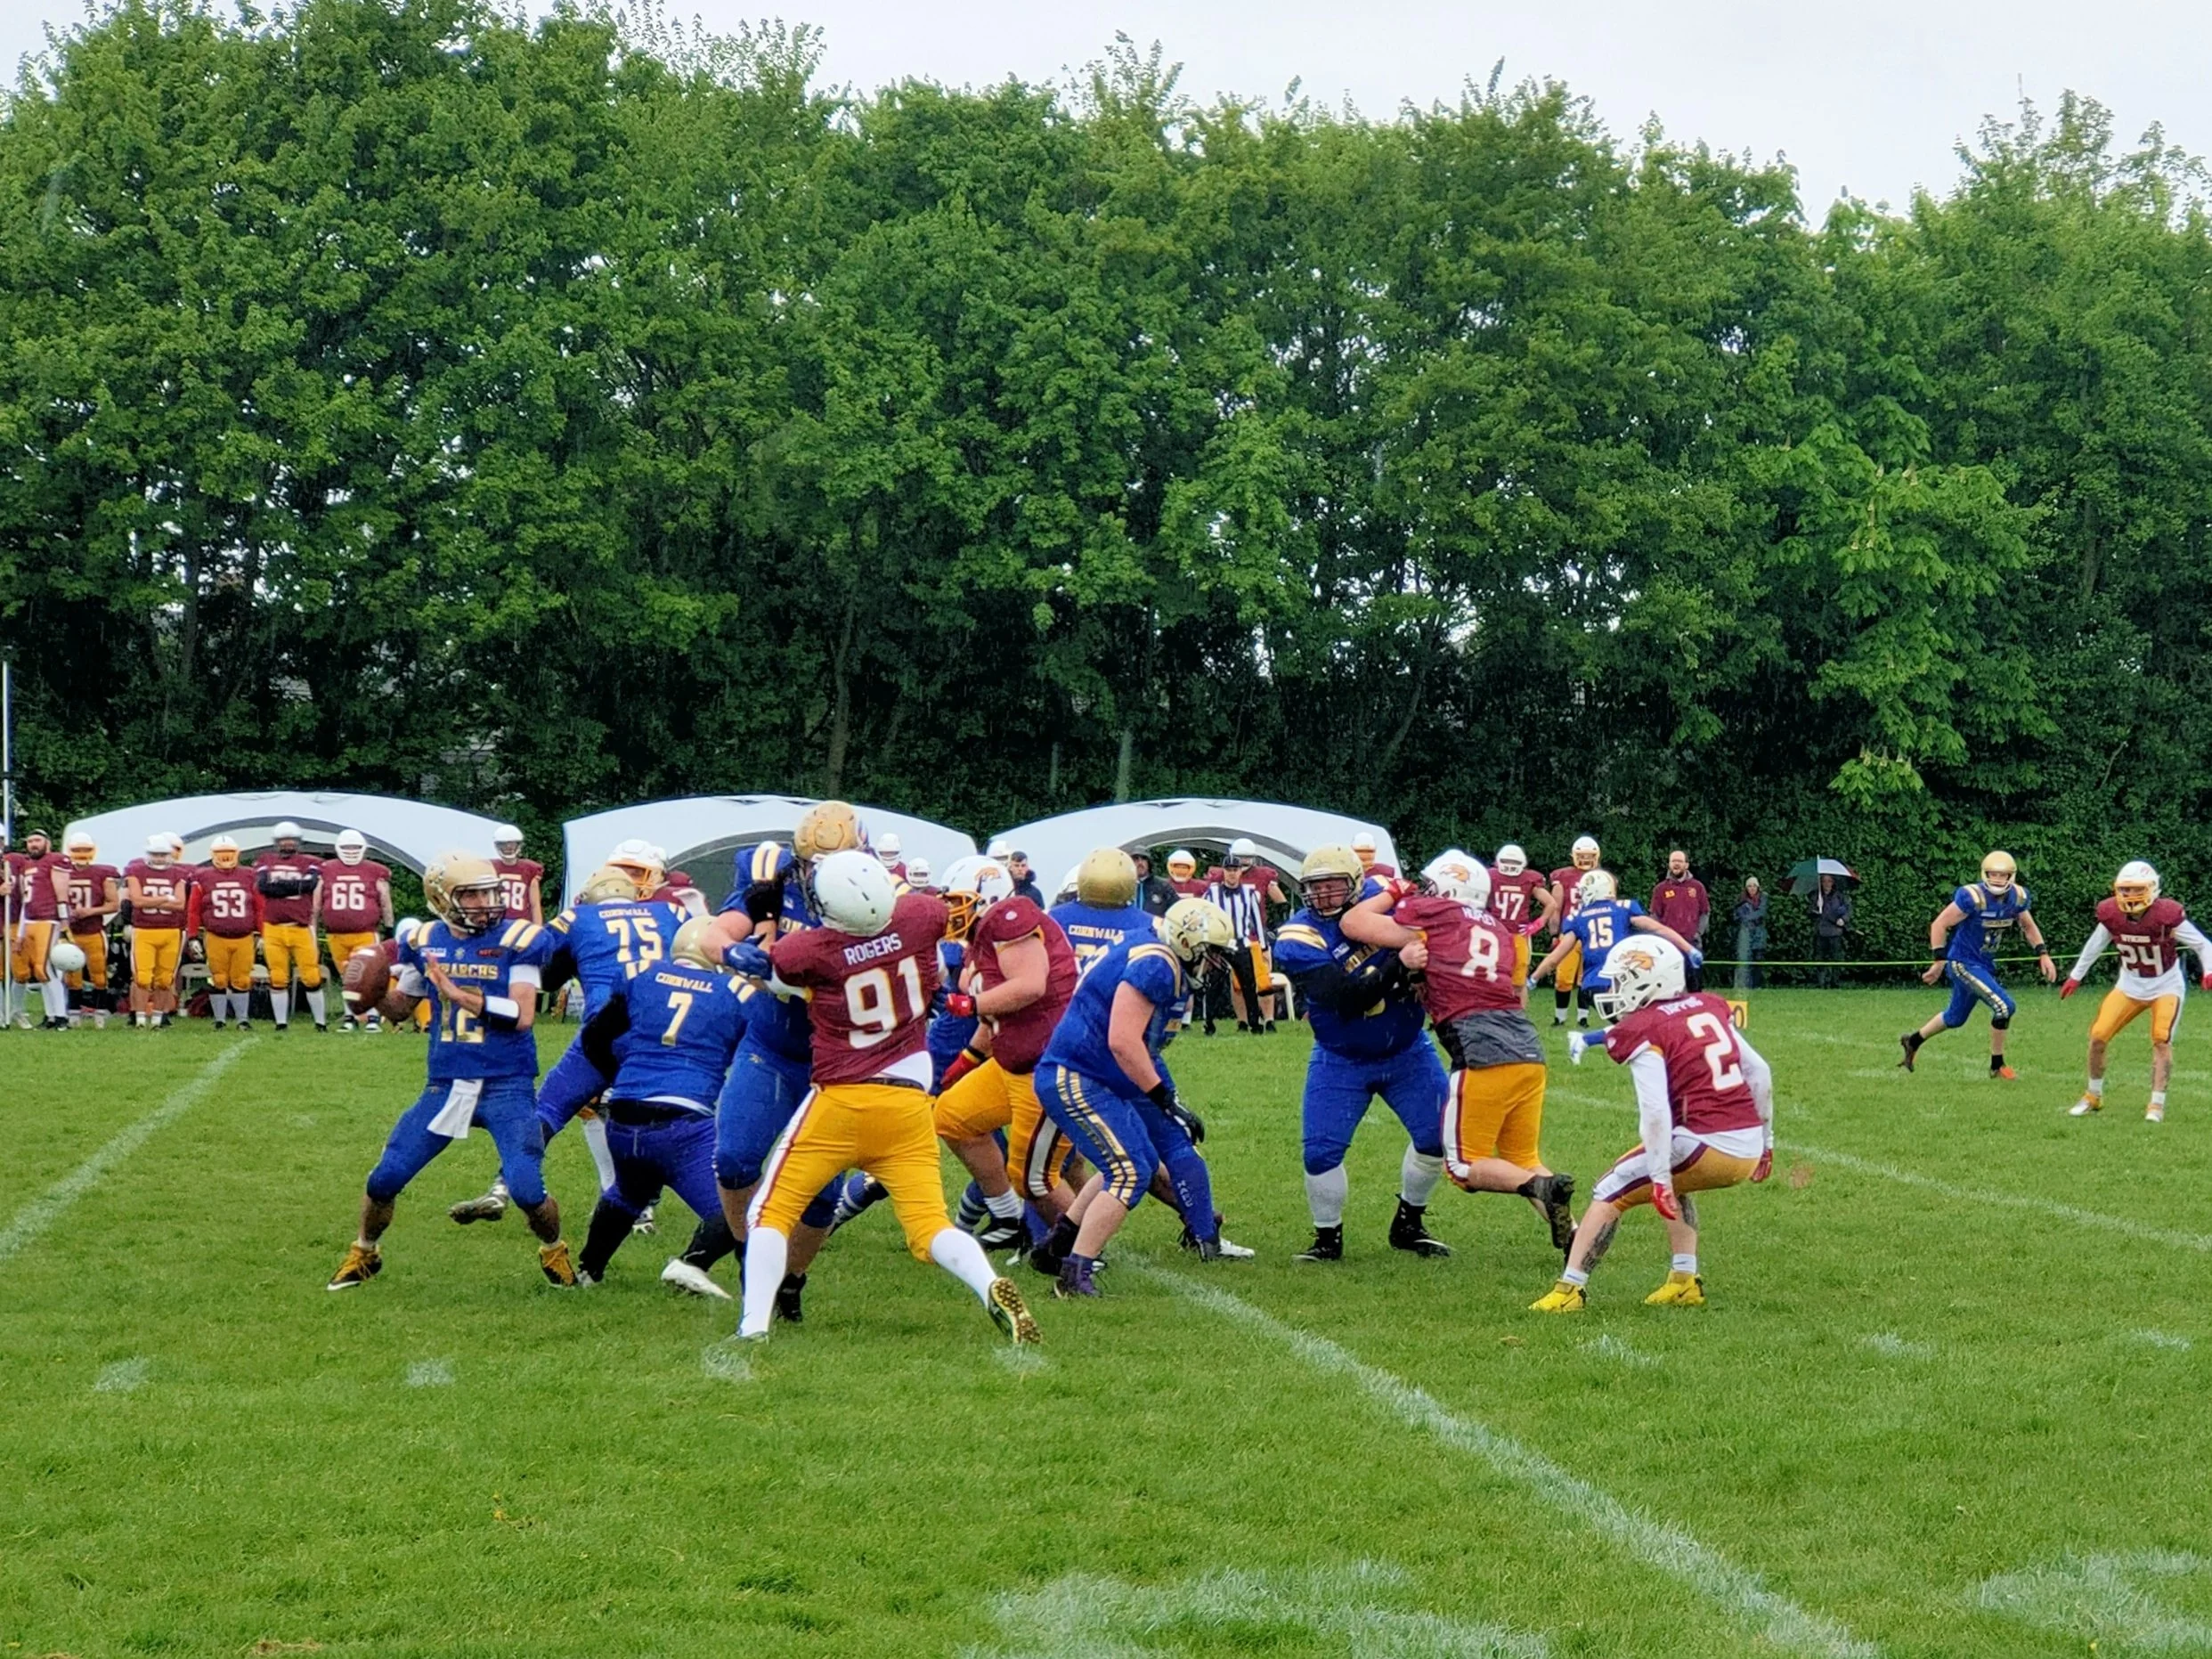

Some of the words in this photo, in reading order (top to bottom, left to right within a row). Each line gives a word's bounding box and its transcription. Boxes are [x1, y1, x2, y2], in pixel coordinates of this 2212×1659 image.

[211, 889, 248, 918] 53
[331, 882, 366, 911] 66
[1494, 890, 1525, 921] 47
[605, 916, 663, 964] 75
[843, 932, 903, 966] ROGERS
[1588, 915, 1614, 950] 15
[1460, 924, 1500, 983] 8
[2116, 943, 2165, 978] 24
[661, 990, 694, 1047] 7
[844, 955, 925, 1050] 91
[1686, 1012, 1744, 1092] 2
